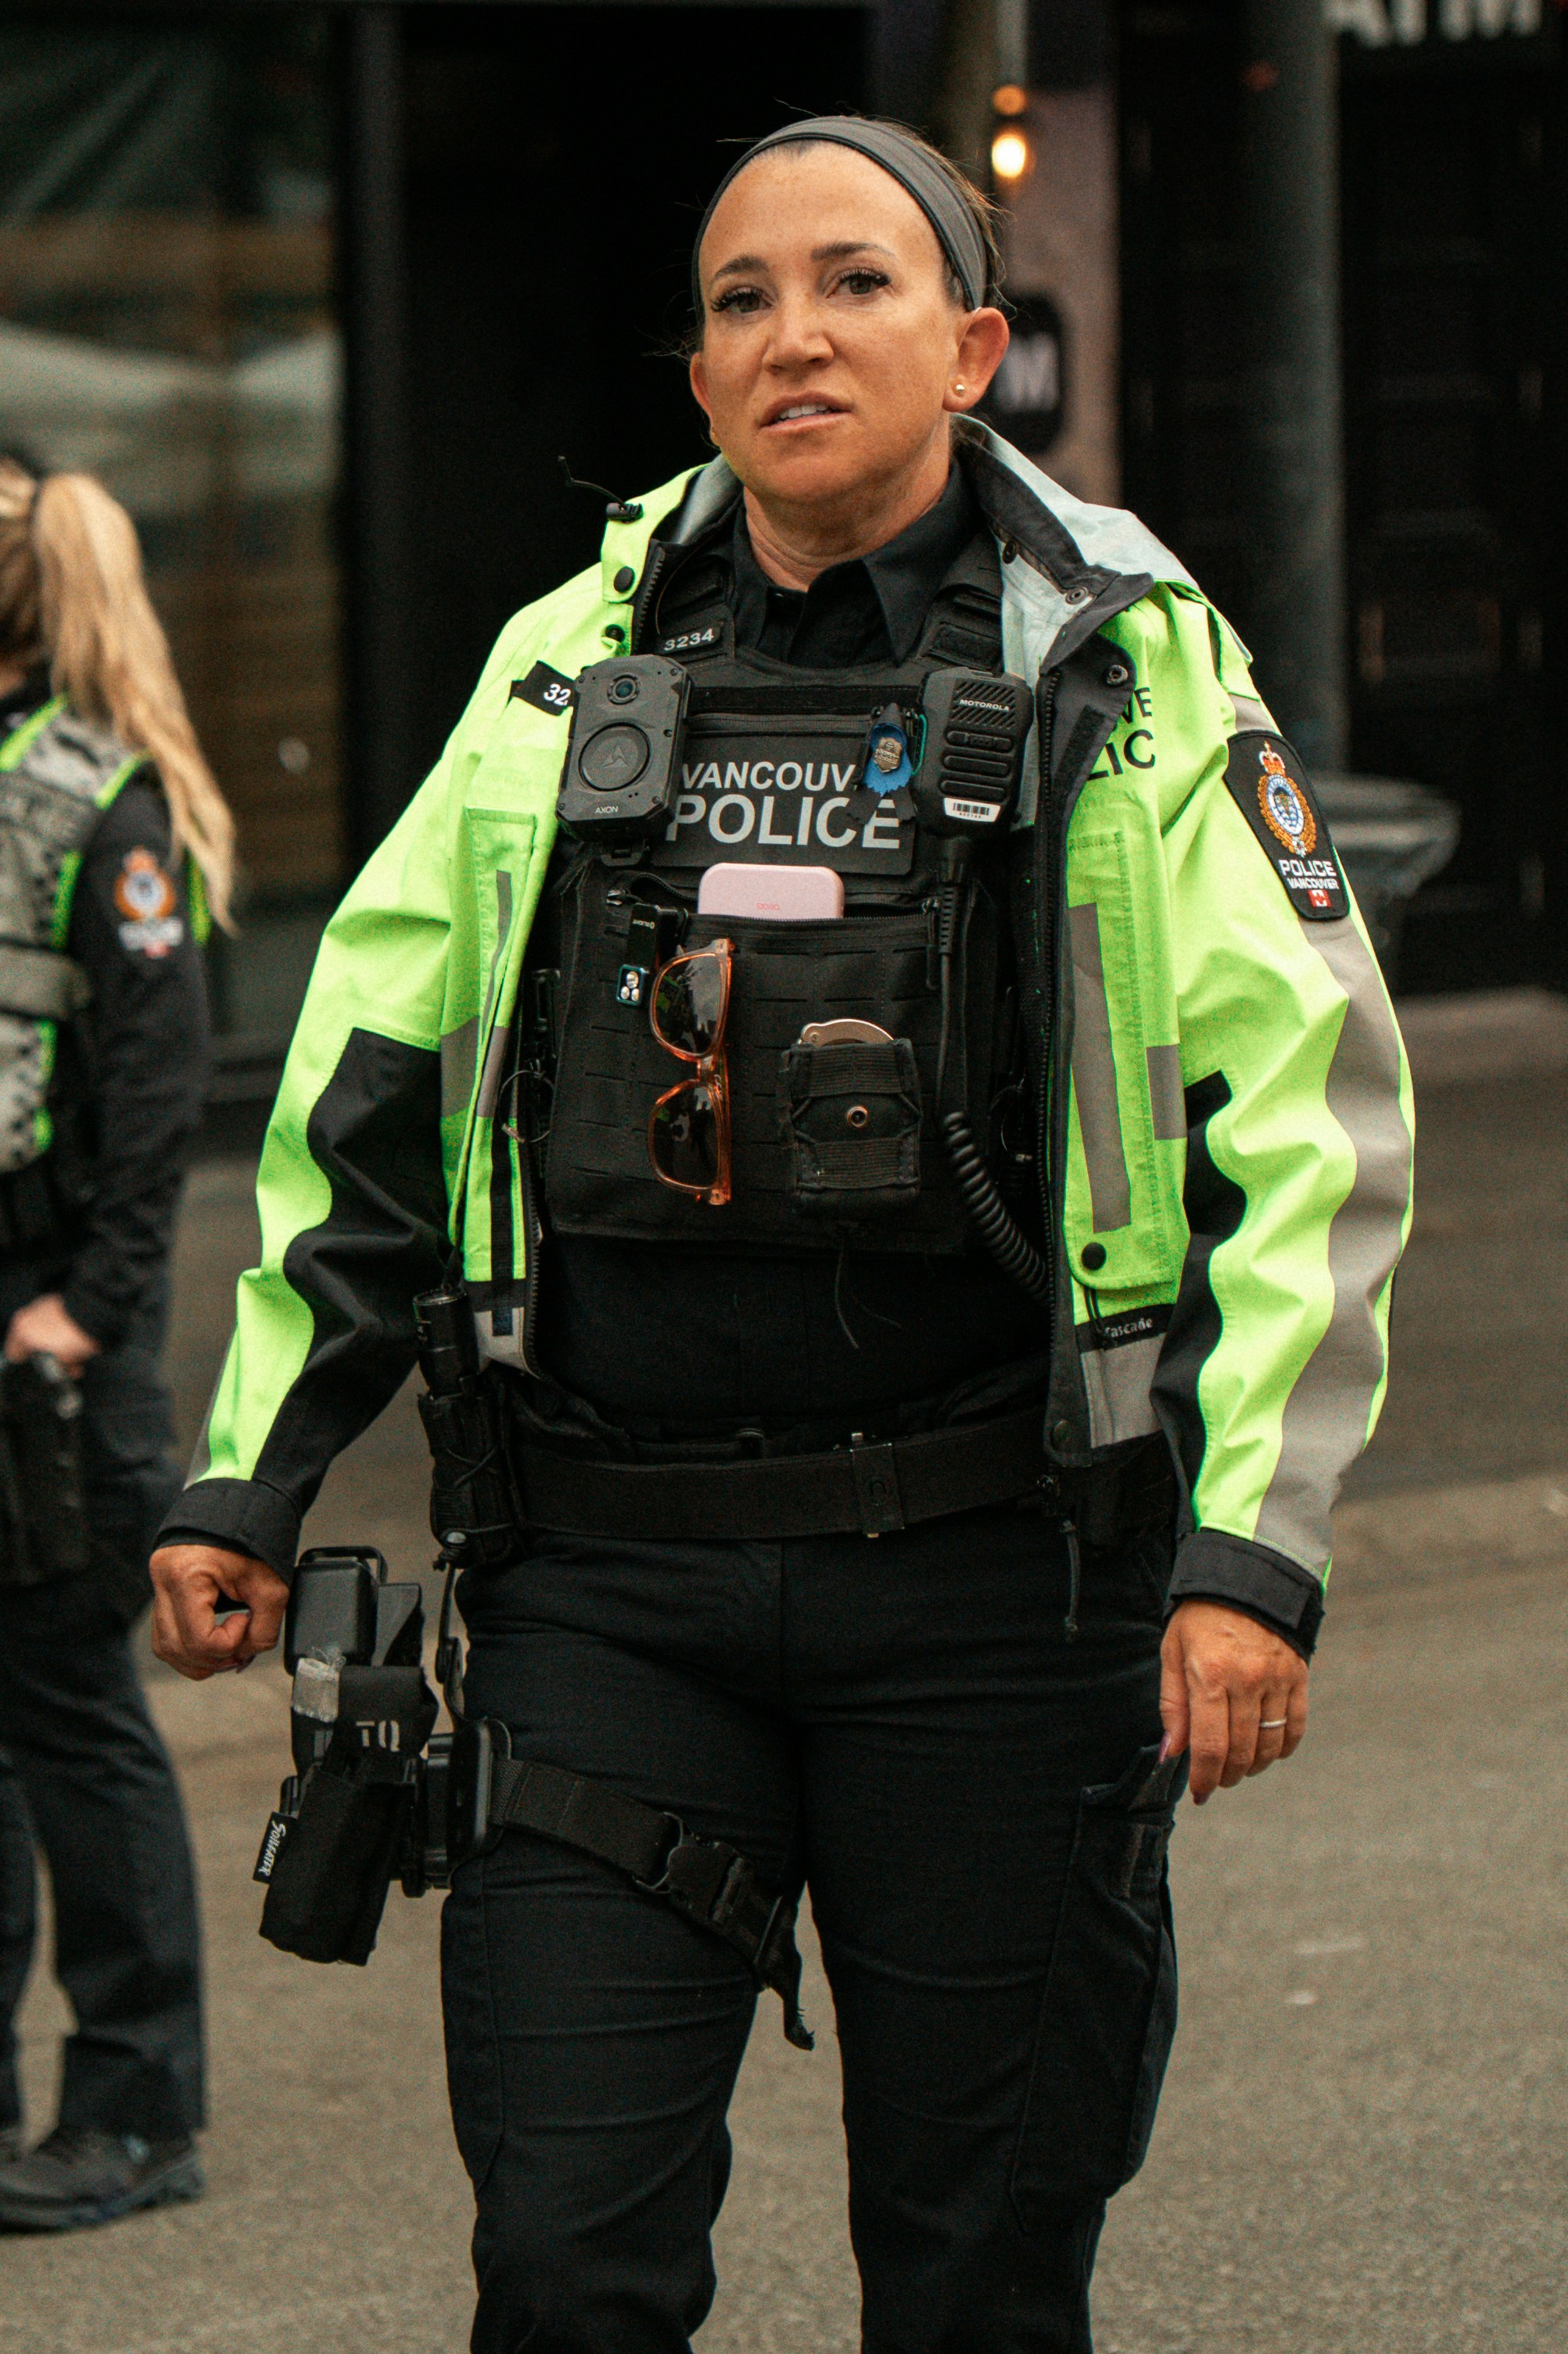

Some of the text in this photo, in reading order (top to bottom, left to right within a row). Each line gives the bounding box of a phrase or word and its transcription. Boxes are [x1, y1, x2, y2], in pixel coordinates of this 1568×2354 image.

[664, 628, 714, 651] 3234
[544, 684, 569, 706] 32
[959, 698, 1010, 712] MOTOROLA
[682, 761, 857, 792] VANCOUV
[594, 806, 619, 814] AXON
[666, 794, 900, 849] POLICE
[1279, 859, 1337, 877] POLICE
[1287, 877, 1340, 890] VANCOUVER
[355, 1720, 400, 1752] TQ
